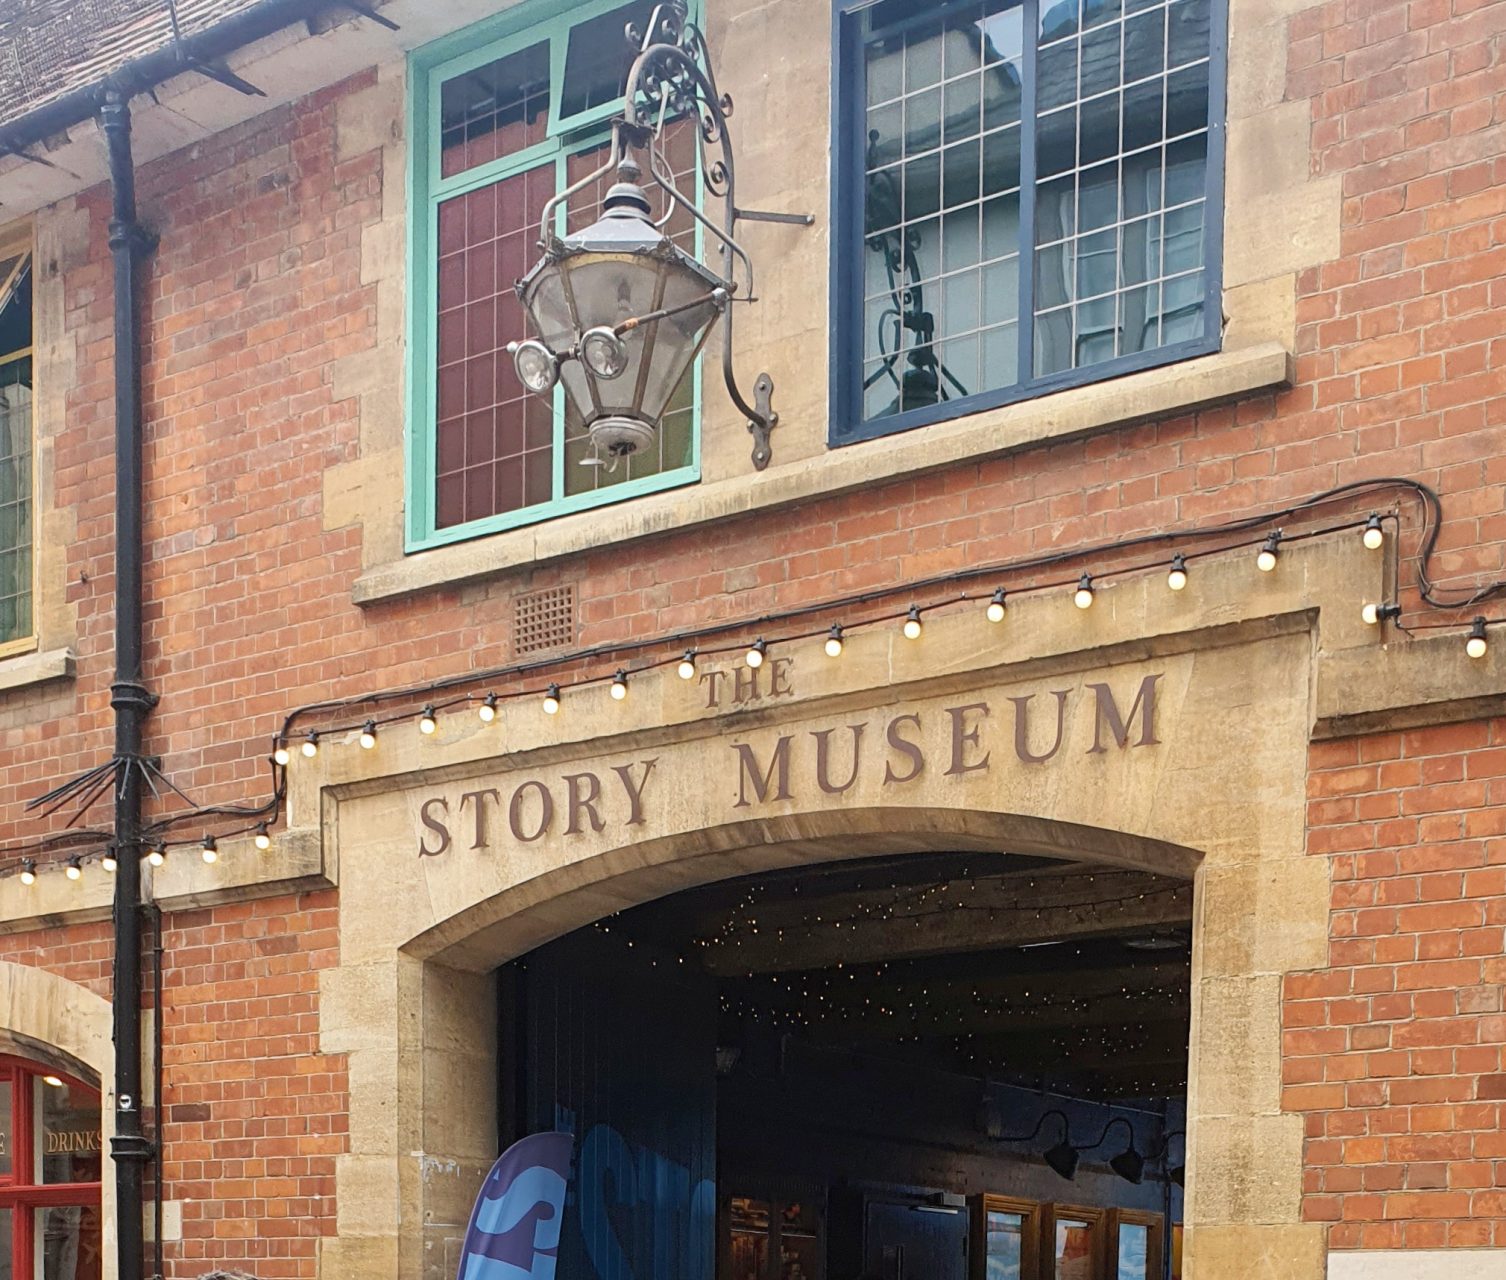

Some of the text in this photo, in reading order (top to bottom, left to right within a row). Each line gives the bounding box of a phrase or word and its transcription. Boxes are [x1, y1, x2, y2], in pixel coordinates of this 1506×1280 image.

[698, 657, 796, 708] THE
[418, 673, 1165, 858] STORY MUSEUM
